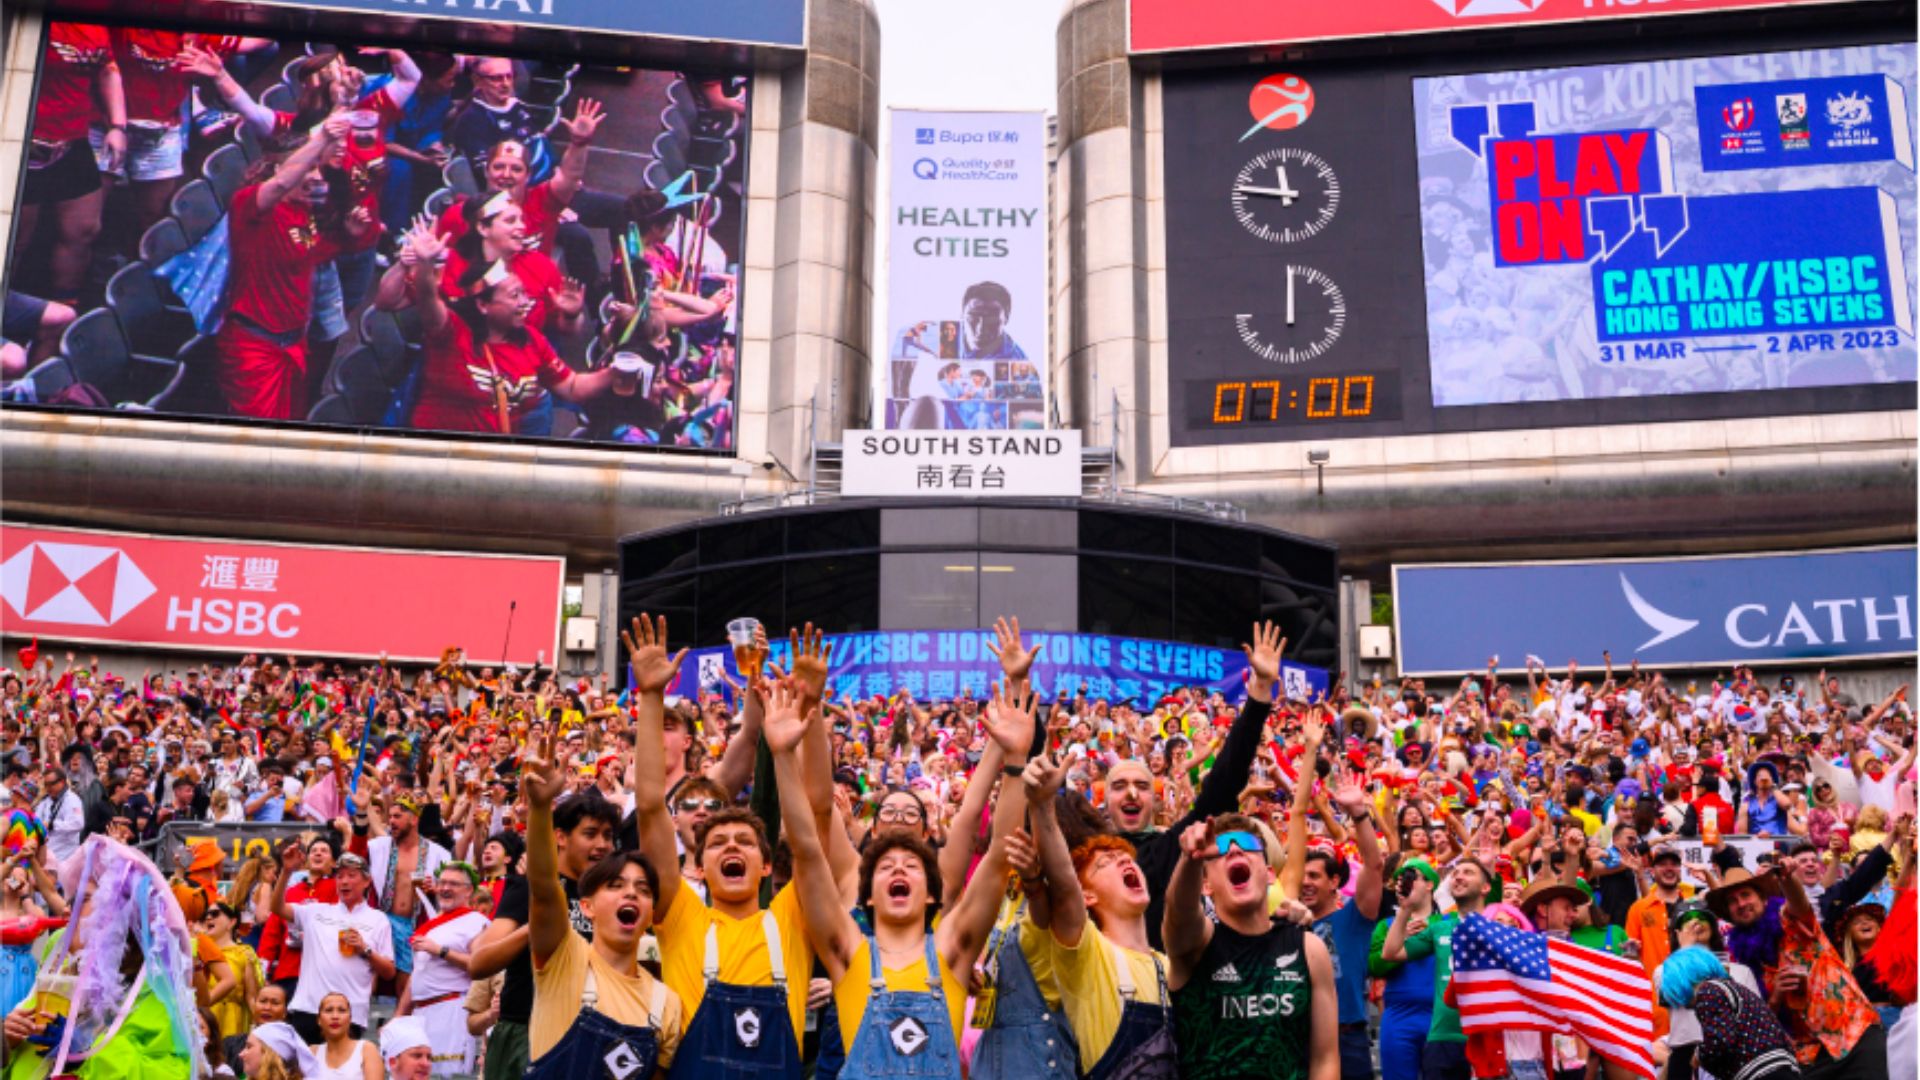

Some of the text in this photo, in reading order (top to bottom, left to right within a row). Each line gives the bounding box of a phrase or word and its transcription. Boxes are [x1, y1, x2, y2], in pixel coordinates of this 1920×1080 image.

[940, 130, 984, 144] Bupa
[942, 158, 991, 170] Quality
[942, 170, 1018, 181] HealthCare
[1494, 132, 1648, 200] PLAY
[897, 206, 1039, 228] HEALTHY
[1498, 198, 1584, 263] ON
[913, 236, 1010, 258] CITIES
[1602, 254, 1880, 307] CATHAY/HSBC
[1605, 293, 1884, 335] HONG KONG SEVENS
[1600, 329, 1899, 362] 31 MAR 2 APR 2023
[1213, 375, 1375, 423] 07:00
[862, 436, 1063, 456] SOUTH STAND
[916, 464, 1006, 489] 南看台
[165, 595, 302, 639] HSBC
[1724, 594, 1914, 649] CATH
[1031, 633, 1112, 668] KONG
[1120, 640, 1225, 681] SEVENS
[1220, 992, 1295, 1019] INEOS
